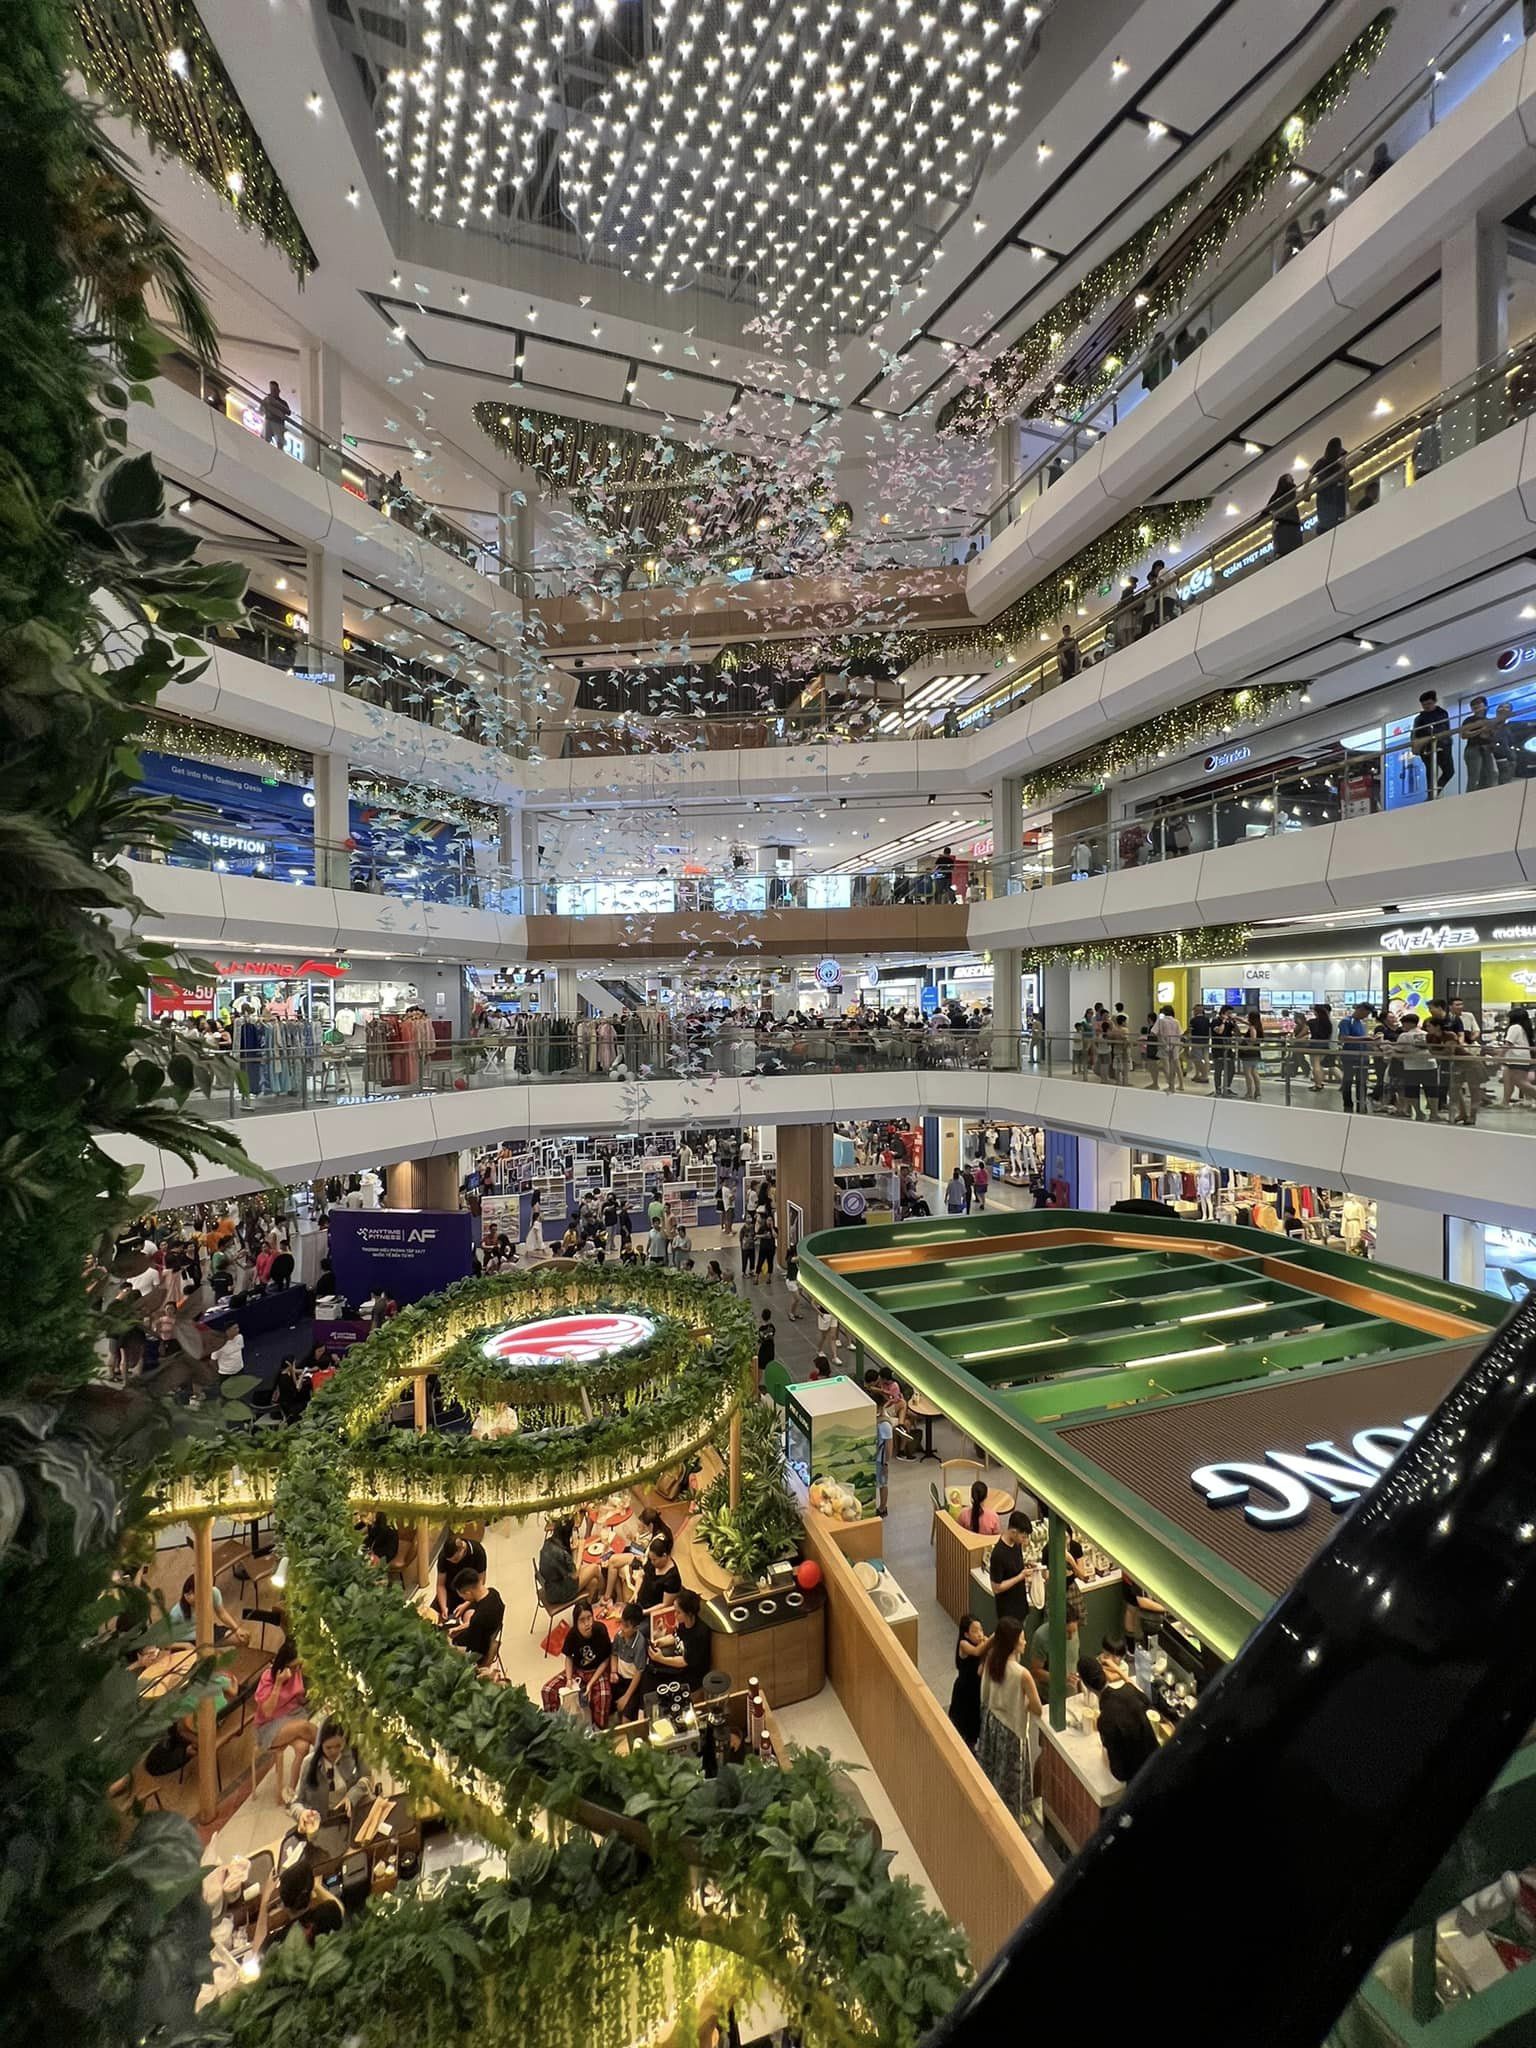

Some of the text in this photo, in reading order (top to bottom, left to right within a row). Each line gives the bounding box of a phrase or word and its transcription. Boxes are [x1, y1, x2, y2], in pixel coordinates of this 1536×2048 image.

[171, 765, 263, 793] Get into the Gaming Oasis
[192, 829, 266, 855] RECEPTION
[1246, 970, 1271, 980] CARE
[407, 1228, 436, 1243] AF
[1191, 1415, 1429, 1522] ONG
